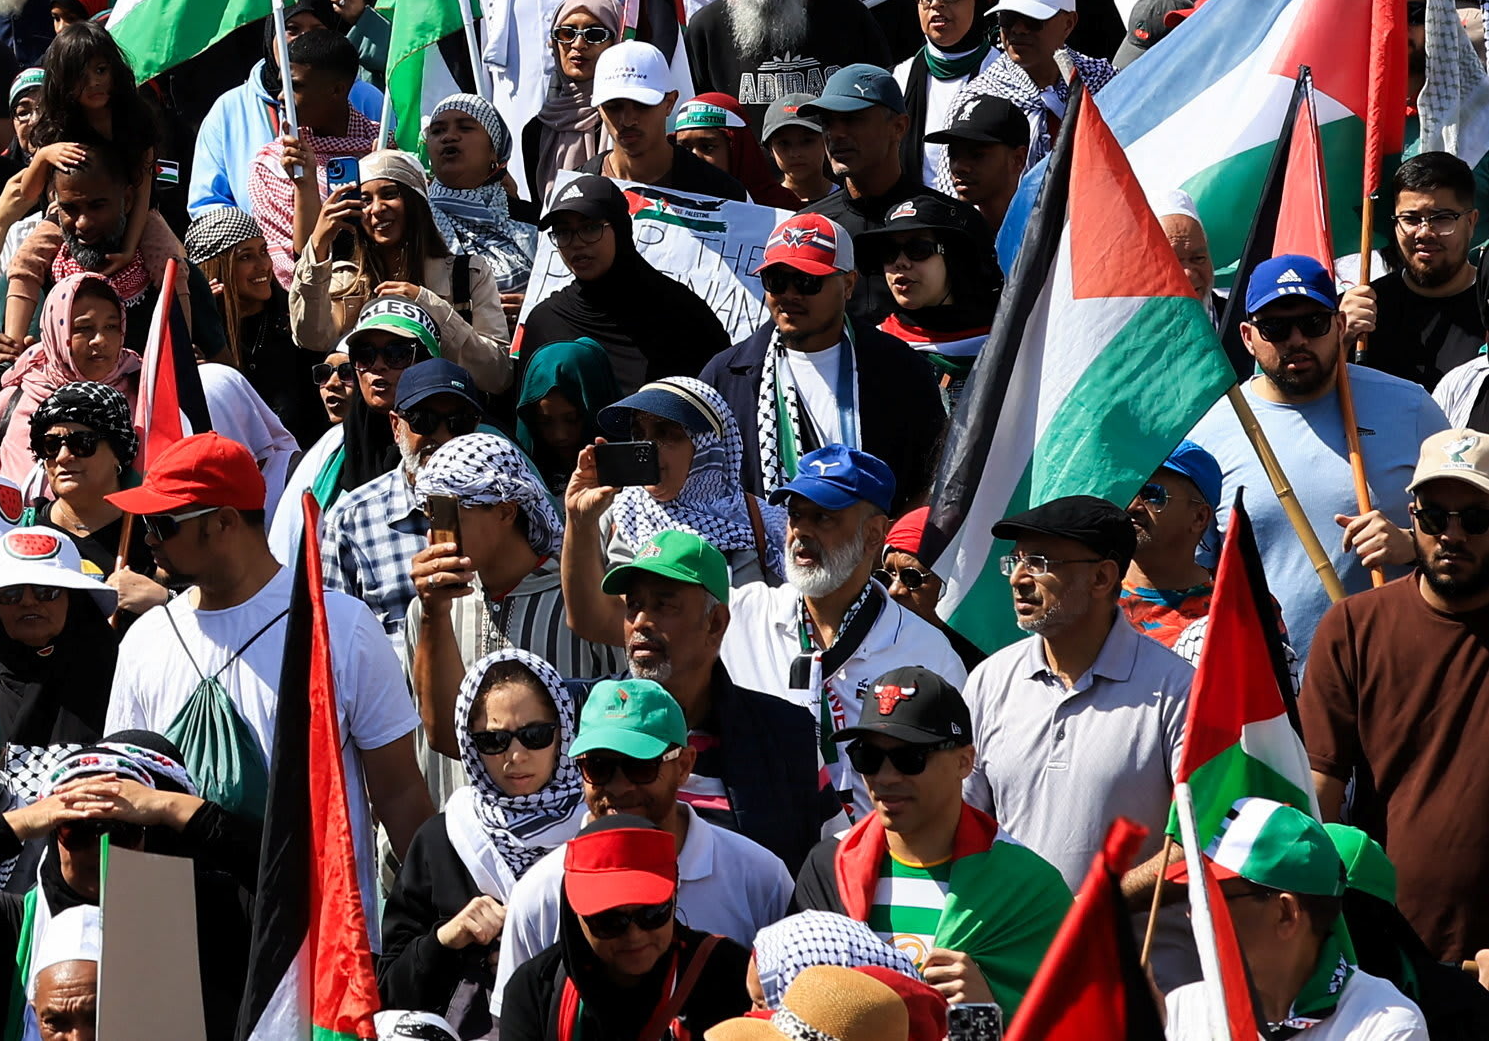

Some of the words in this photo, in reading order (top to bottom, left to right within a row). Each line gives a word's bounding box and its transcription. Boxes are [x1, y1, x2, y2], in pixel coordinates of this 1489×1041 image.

[687, 103, 707, 112] FREE
[708, 104, 728, 114] FREE
[686, 113, 727, 125] PALESTINE
[684, 210, 710, 219] PALESTINE
[691, 235, 766, 278] THE
